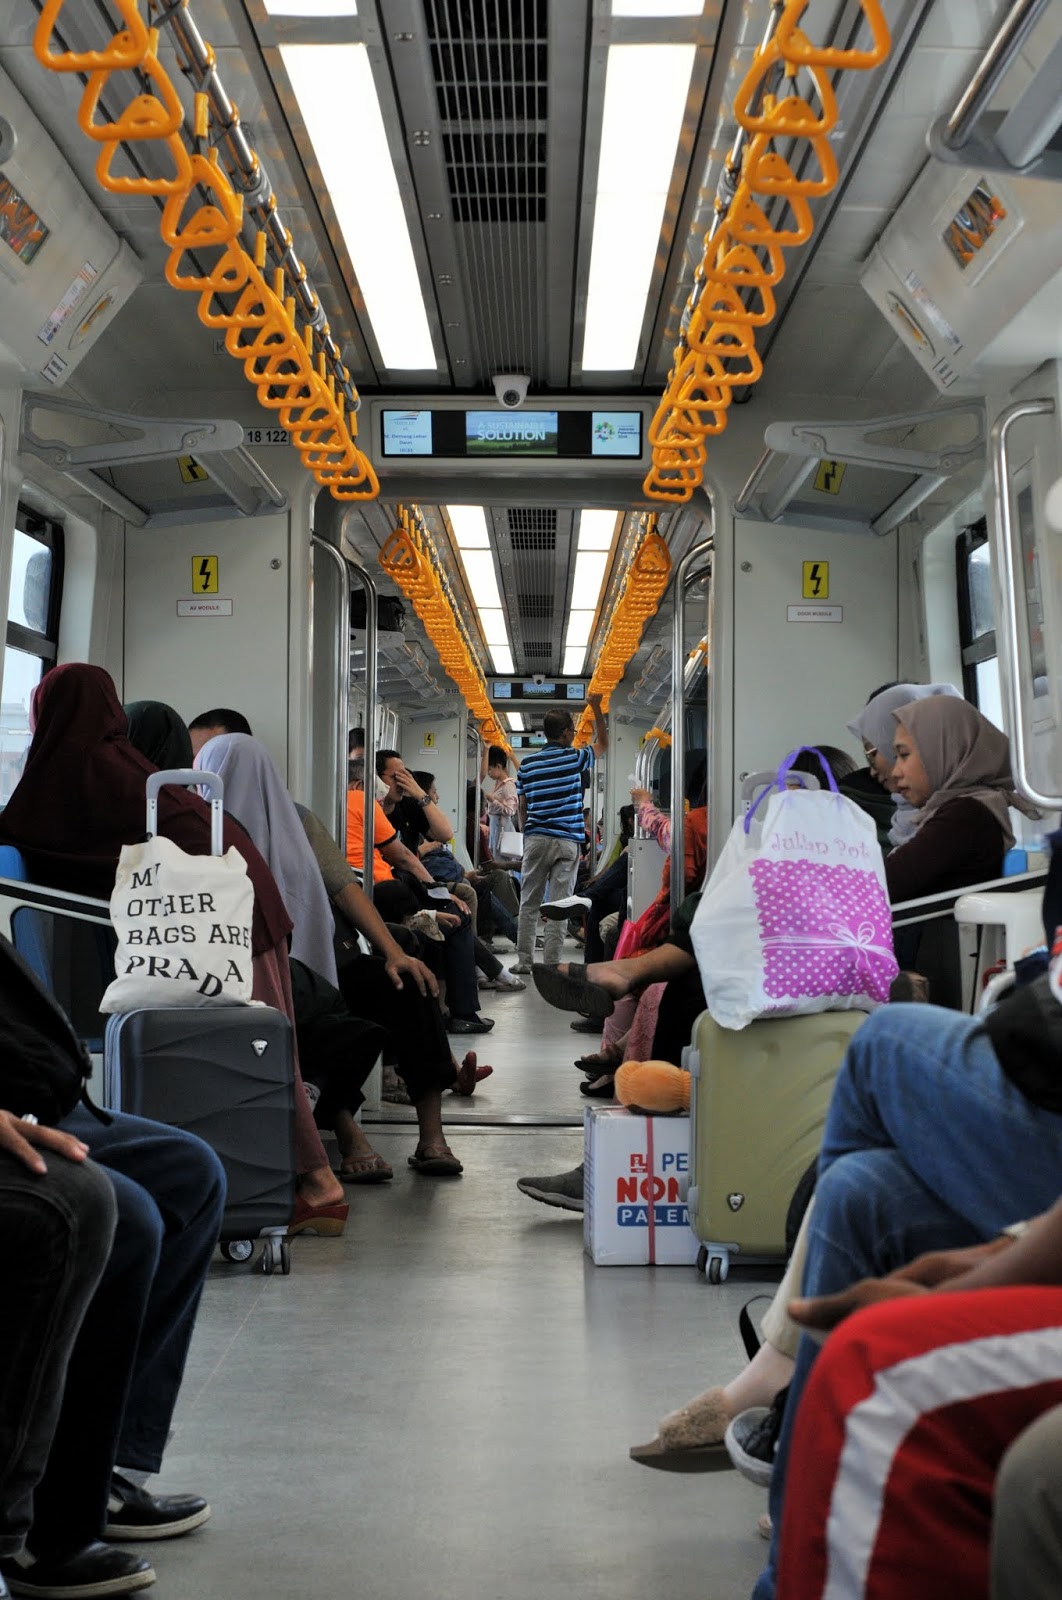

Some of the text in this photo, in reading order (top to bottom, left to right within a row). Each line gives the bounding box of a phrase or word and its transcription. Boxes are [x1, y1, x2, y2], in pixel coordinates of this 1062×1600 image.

[247, 430, 288, 443] 18 122
[477, 429, 546, 441] SOLUTION
[127, 892, 217, 918] OTHER
[126, 923, 250, 949] BAGS ARE
[124, 955, 245, 998] PRADA
[661, 1152, 689, 1172] PE
